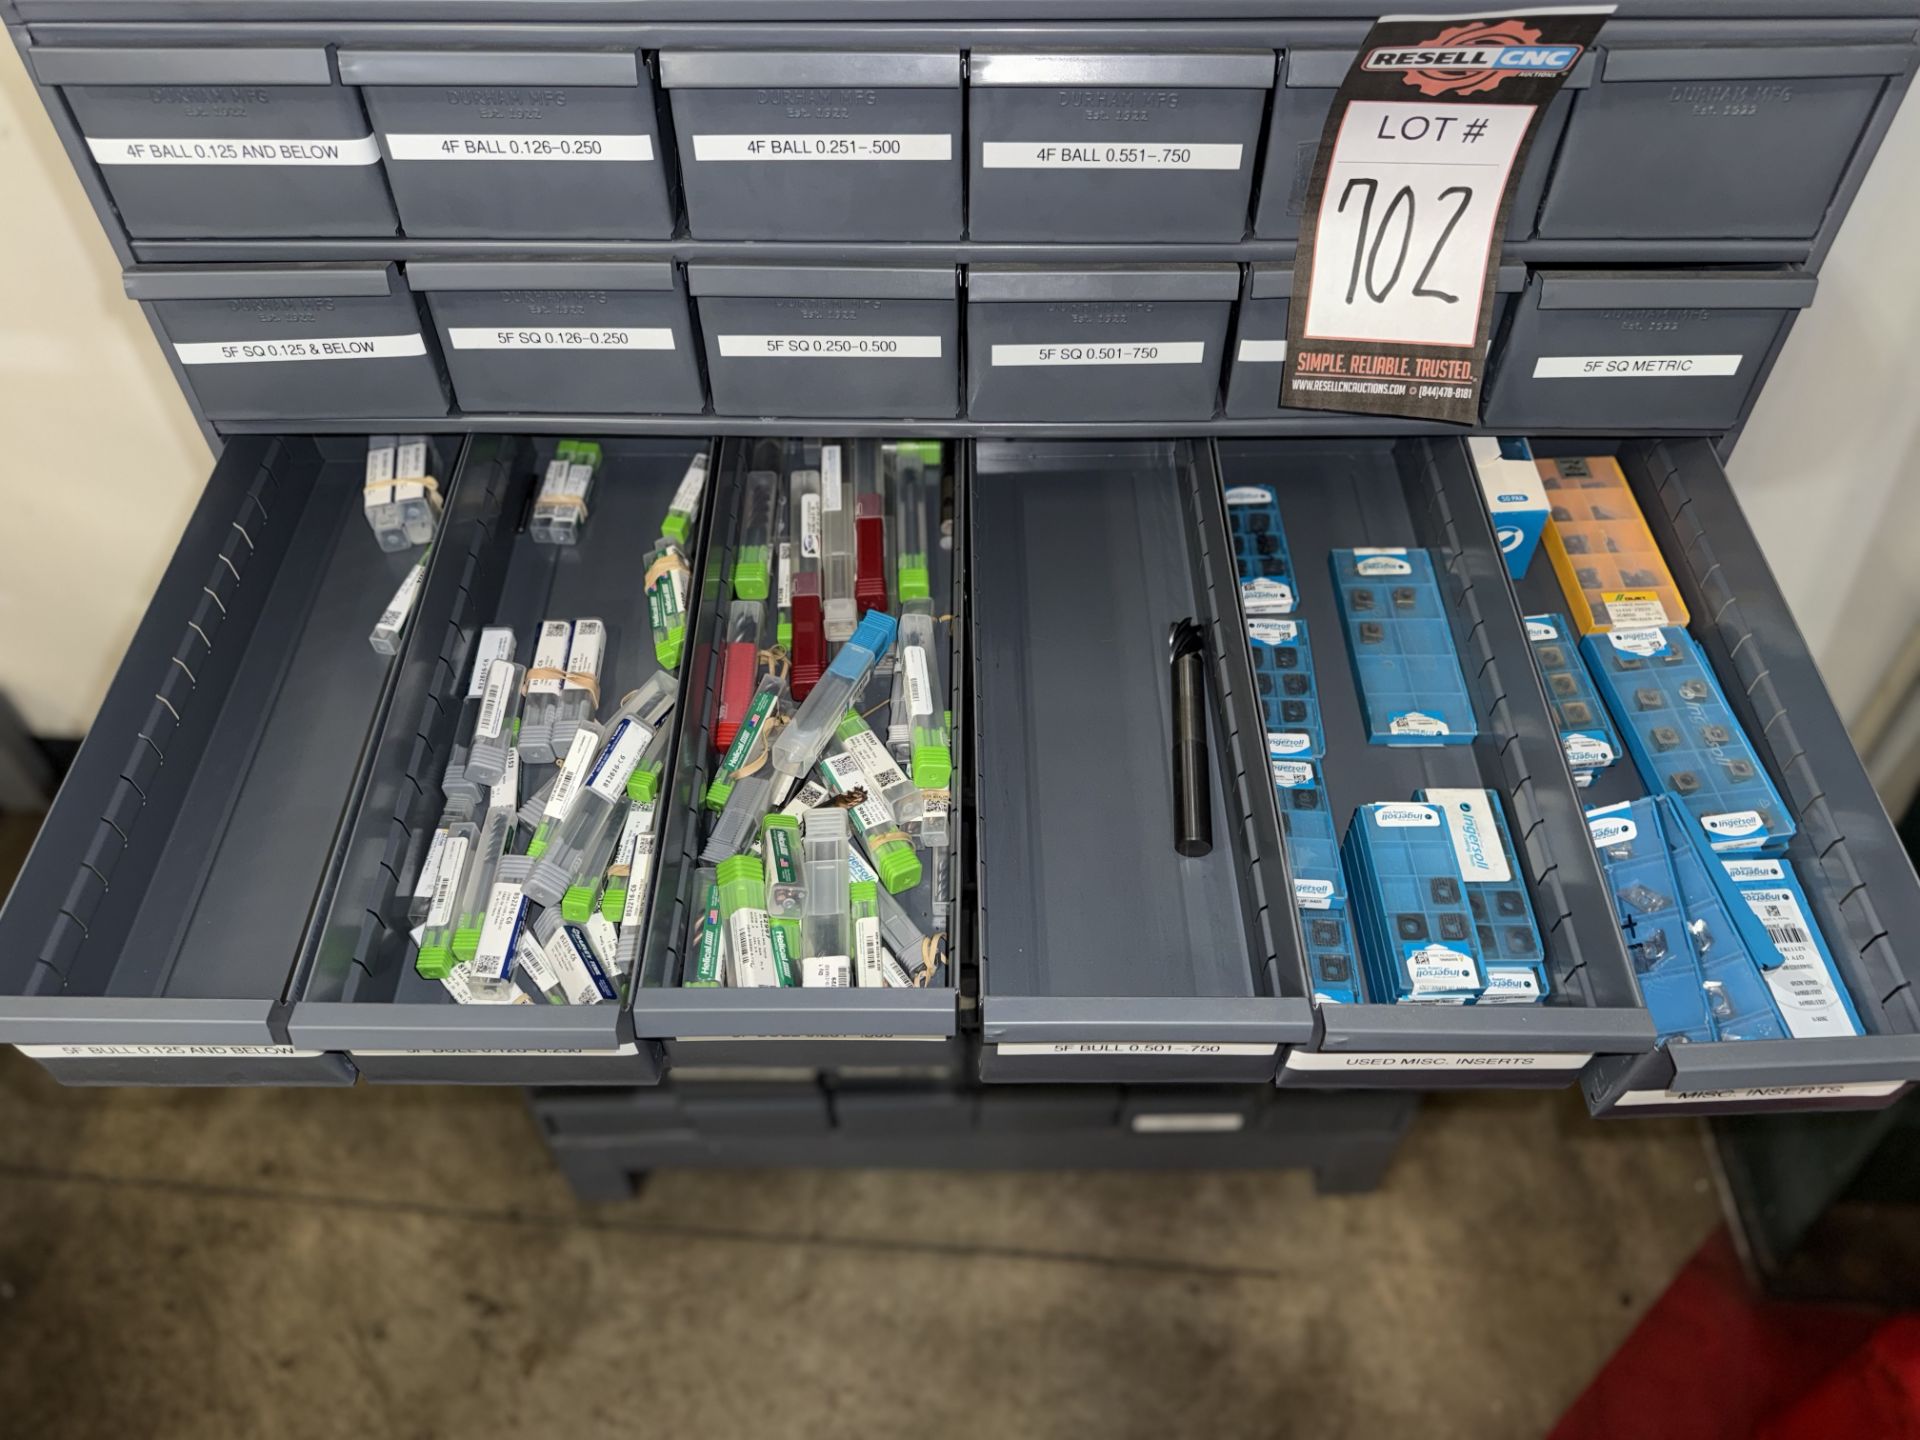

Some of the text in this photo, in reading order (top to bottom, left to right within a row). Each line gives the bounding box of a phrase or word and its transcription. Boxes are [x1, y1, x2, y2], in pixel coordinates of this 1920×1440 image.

[1373, 50, 1571, 66] RESELL CNC
[840, 88, 878, 106] MFG
[1141, 91, 1180, 109] MFG
[1377, 115, 1489, 143] LOT #
[127, 144, 339, 160] 4F BALL 0.125 AND BELOW
[441, 139, 602, 154] 4F BALL 0.126-0.250
[747, 140, 901, 155] 4F BALL 0.251-.500
[1036, 147, 1191, 163] 4F BALL 0.551-.750
[1337, 178, 1473, 304] 702
[497, 332, 629, 345] 5F SQ 0.126-0.250
[221, 341, 376, 359] 5F SQ 0.125 & BELOW
[766, 340, 897, 353] 5F SQ 0.250-0.500
[1039, 347, 1159, 361] 5F SQ 0.501-750
[1297, 352, 1474, 380] SIMPLE. RELIABLE. TRUSTED.
[1583, 359, 1694, 373] 5F SQ METRIC
[1292, 379, 1406, 396] WWW.RESELLCNCAUCTIONS.COM
[1381, 813, 1423, 822] Ingersoll
[1719, 816, 1757, 829] Ingersoll
[1463, 813, 1489, 870] Ingersoll
[1415, 969, 1460, 978] Ingersoll
[61, 1046, 295, 1056] 5F BULL 0.125 AND BELOW
[1054, 1044, 1075, 1053] 5F
[1079, 1044, 1123, 1053] BULL
[1345, 1057, 1536, 1067] USED MISC. INSERTS
[1676, 1084, 1846, 1100] MISC. INSERTS
